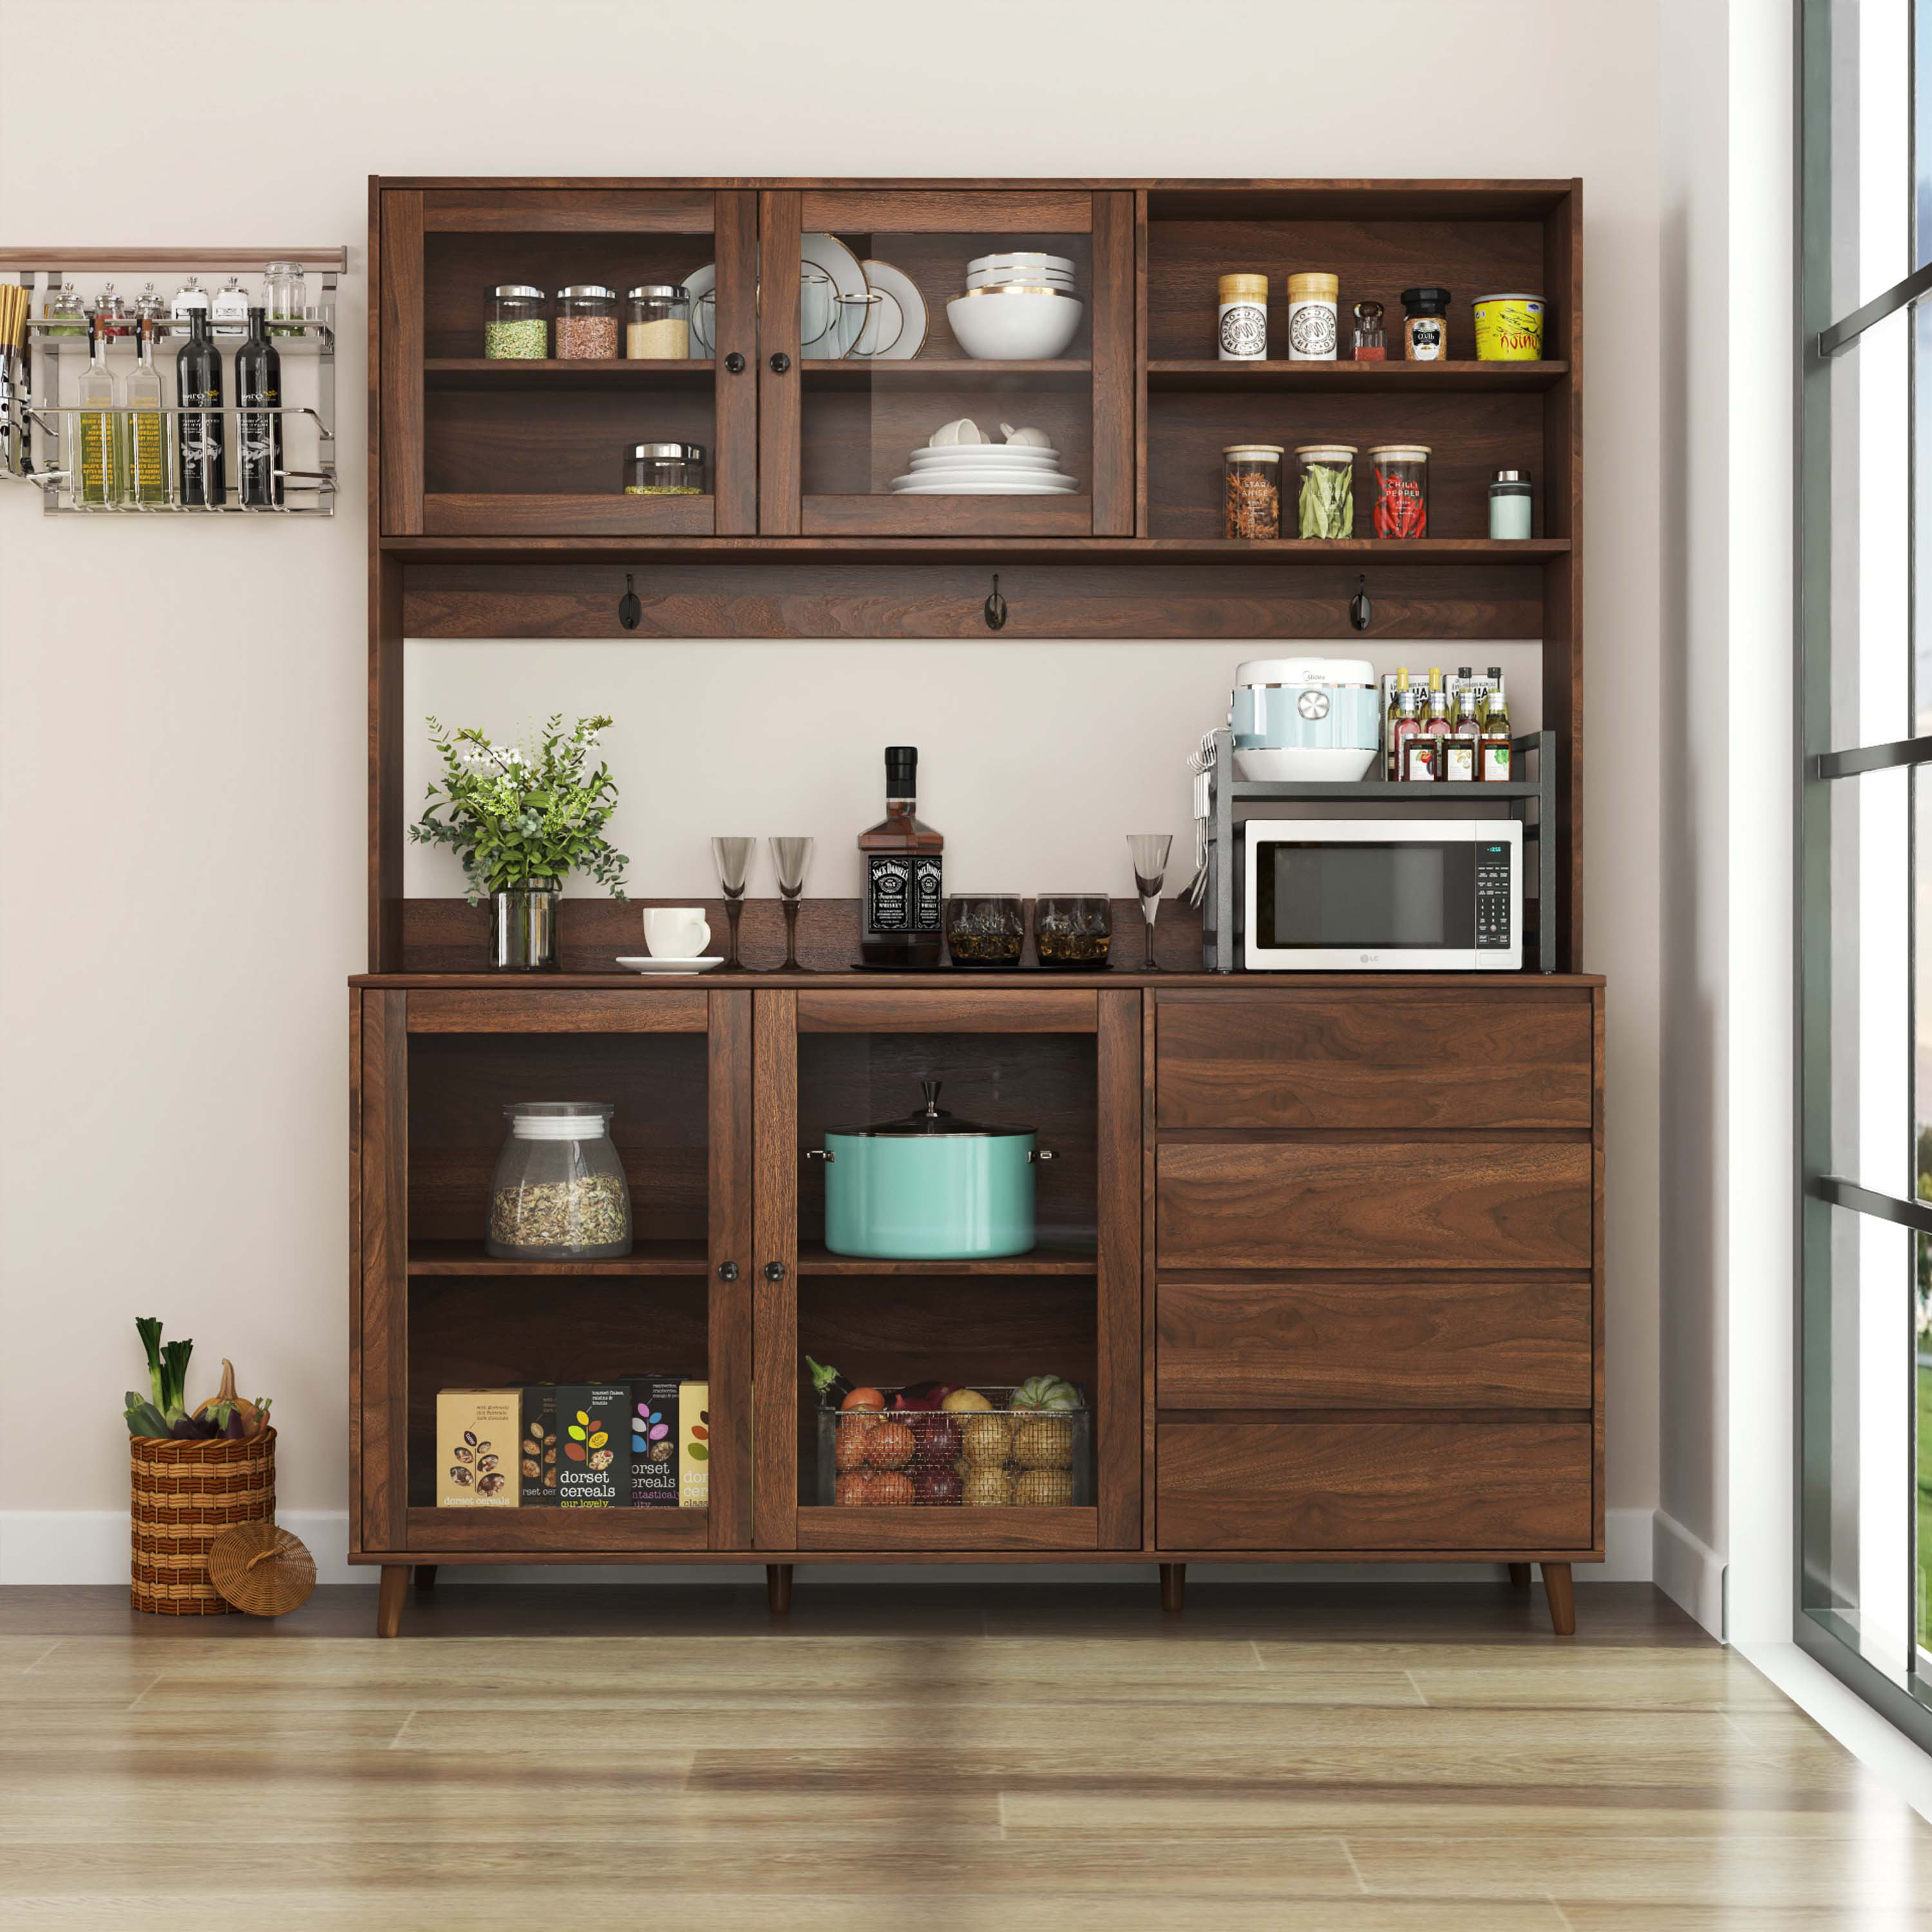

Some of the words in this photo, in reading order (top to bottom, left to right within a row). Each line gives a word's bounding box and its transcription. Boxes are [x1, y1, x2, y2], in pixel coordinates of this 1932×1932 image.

[632, 1463, 670, 1474] orset
[560, 1471, 610, 1483] dorset
[632, 1476, 676, 1488] ereals
[684, 1470, 708, 1483] dor
[522, 1488, 541, 1496] rset
[560, 1485, 616, 1497] cereals
[444, 1497, 475, 1505] dorset
[475, 1497, 510, 1505] cereals
[580, 1499, 609, 1508] lovely
